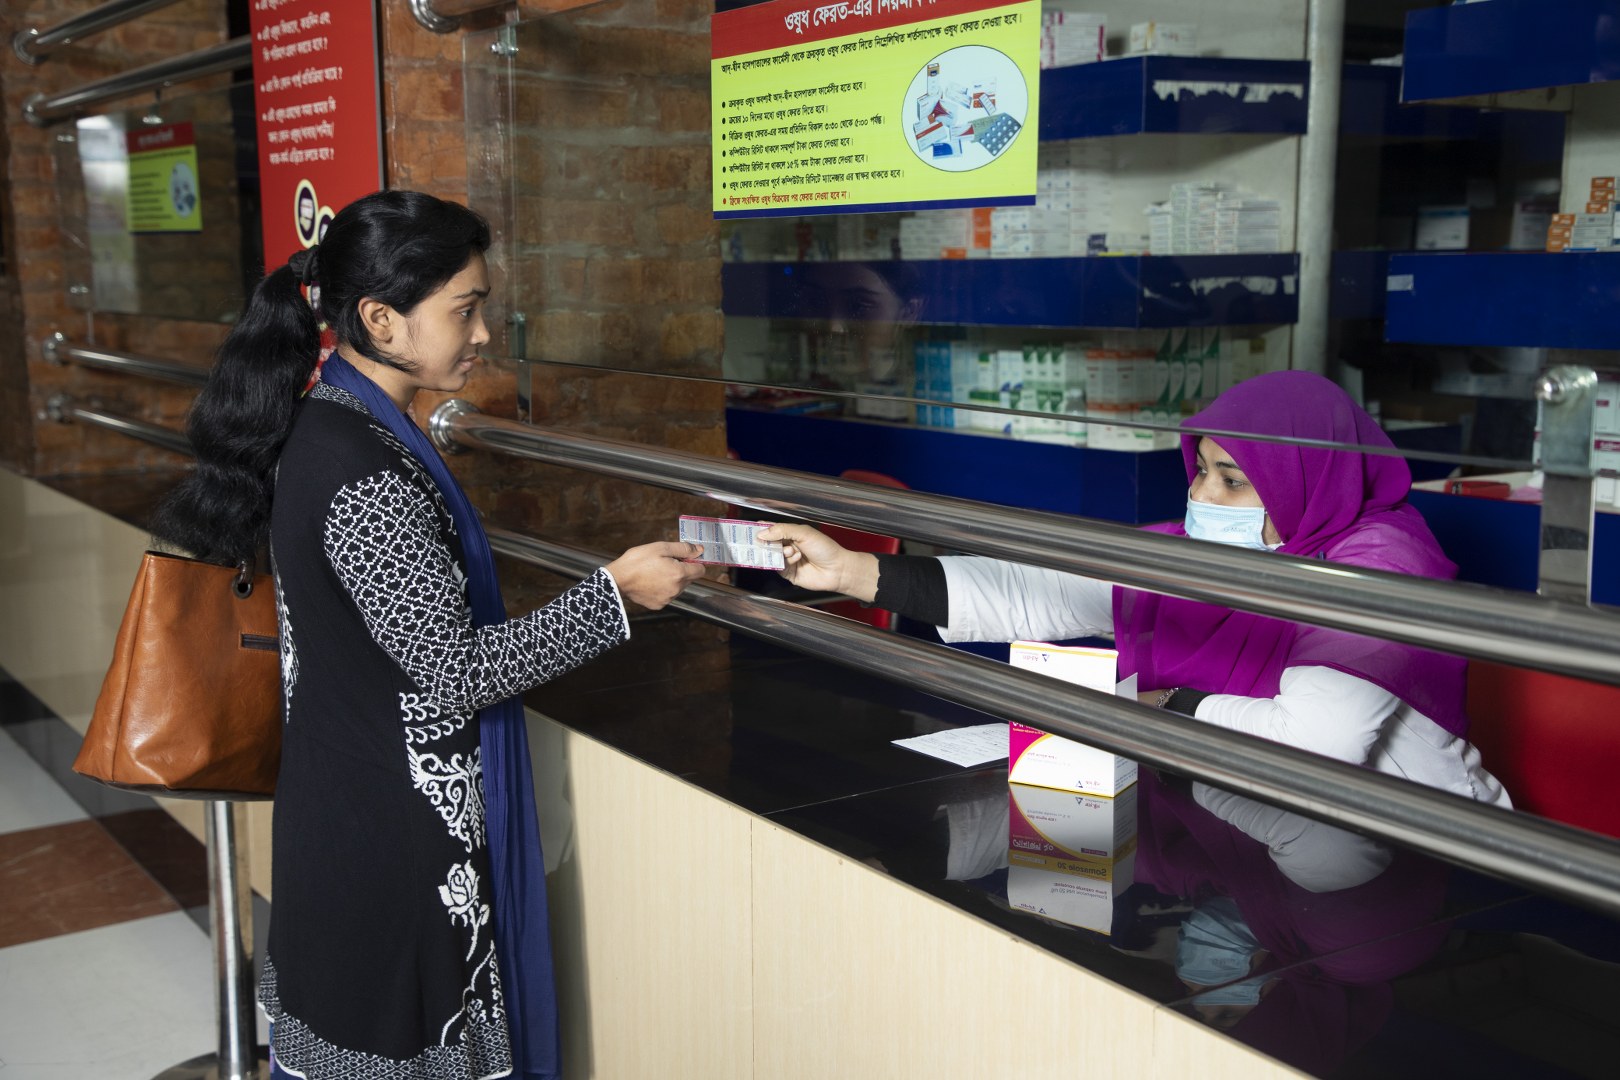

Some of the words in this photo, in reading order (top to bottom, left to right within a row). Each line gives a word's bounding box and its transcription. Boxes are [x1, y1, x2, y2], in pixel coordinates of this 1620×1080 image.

[784, 10, 810, 34] ওষুধ
[813, 0, 872, 26] ফেরত-এর
[742, 57, 771, 71] হাসপাতালের
[791, 53, 805, 63] থেকে
[827, 45, 840, 57] ওষুধ
[840, 42, 857, 54] ফেরত
[944, 24, 958, 36] ওষুধ
[960, 20, 979, 33] ফেরত
[840, 83, 852, 92] হতে
[787, 108, 801, 117] ফেরত
[840, 119, 853, 129] থেকে
[808, 140, 822, 149] ফেরত
[822, 156, 837, 165] ফেরত
